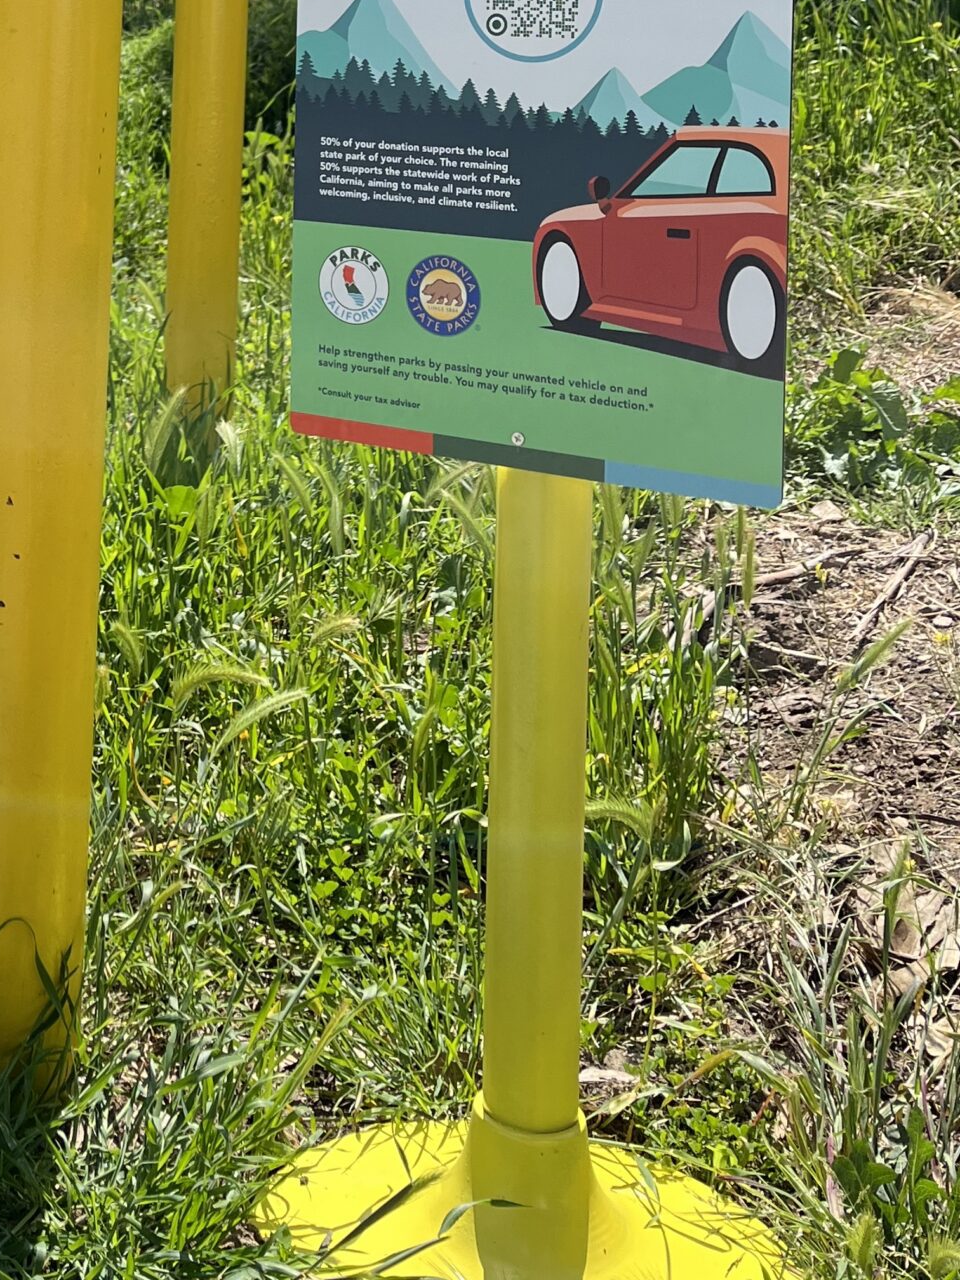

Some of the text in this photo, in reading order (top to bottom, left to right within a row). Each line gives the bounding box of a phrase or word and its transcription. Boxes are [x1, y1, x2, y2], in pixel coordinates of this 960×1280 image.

[320, 136, 509, 158] 50% of your donation supports the local
[320, 150, 509, 173] state park of your choice. The remaining
[320, 161, 521, 185] 50% supports the statewide work of Parks
[320, 174, 511, 198] California, aiming to make all parks more
[319, 187, 518, 212] welcoming, inclusive, and climate resilient.
[329, 248, 381, 273] PARKS
[411, 257, 476, 293] CALIFORNIA
[324, 291, 385, 321] CALIFORNIA
[409, 296, 477, 333] STATE PARKS
[318, 344, 648, 397] Help strengthen parks by passing your unwanted vehicle on and
[318, 359, 348, 372] saving
[350, 363, 390, 376] yourself
[392, 369, 410, 381] any
[413, 371, 452, 385] trouble.
[455, 376, 474, 387] You
[477, 381, 499, 393] may
[501, 384, 537, 399] qualify
[540, 387, 556, 399] for
[559, 392, 566, 400] a
[568, 392, 586, 403] tax
[353, 393, 372, 402] your
[374, 395, 388, 404] tax
[390, 399, 421, 409] advisor
